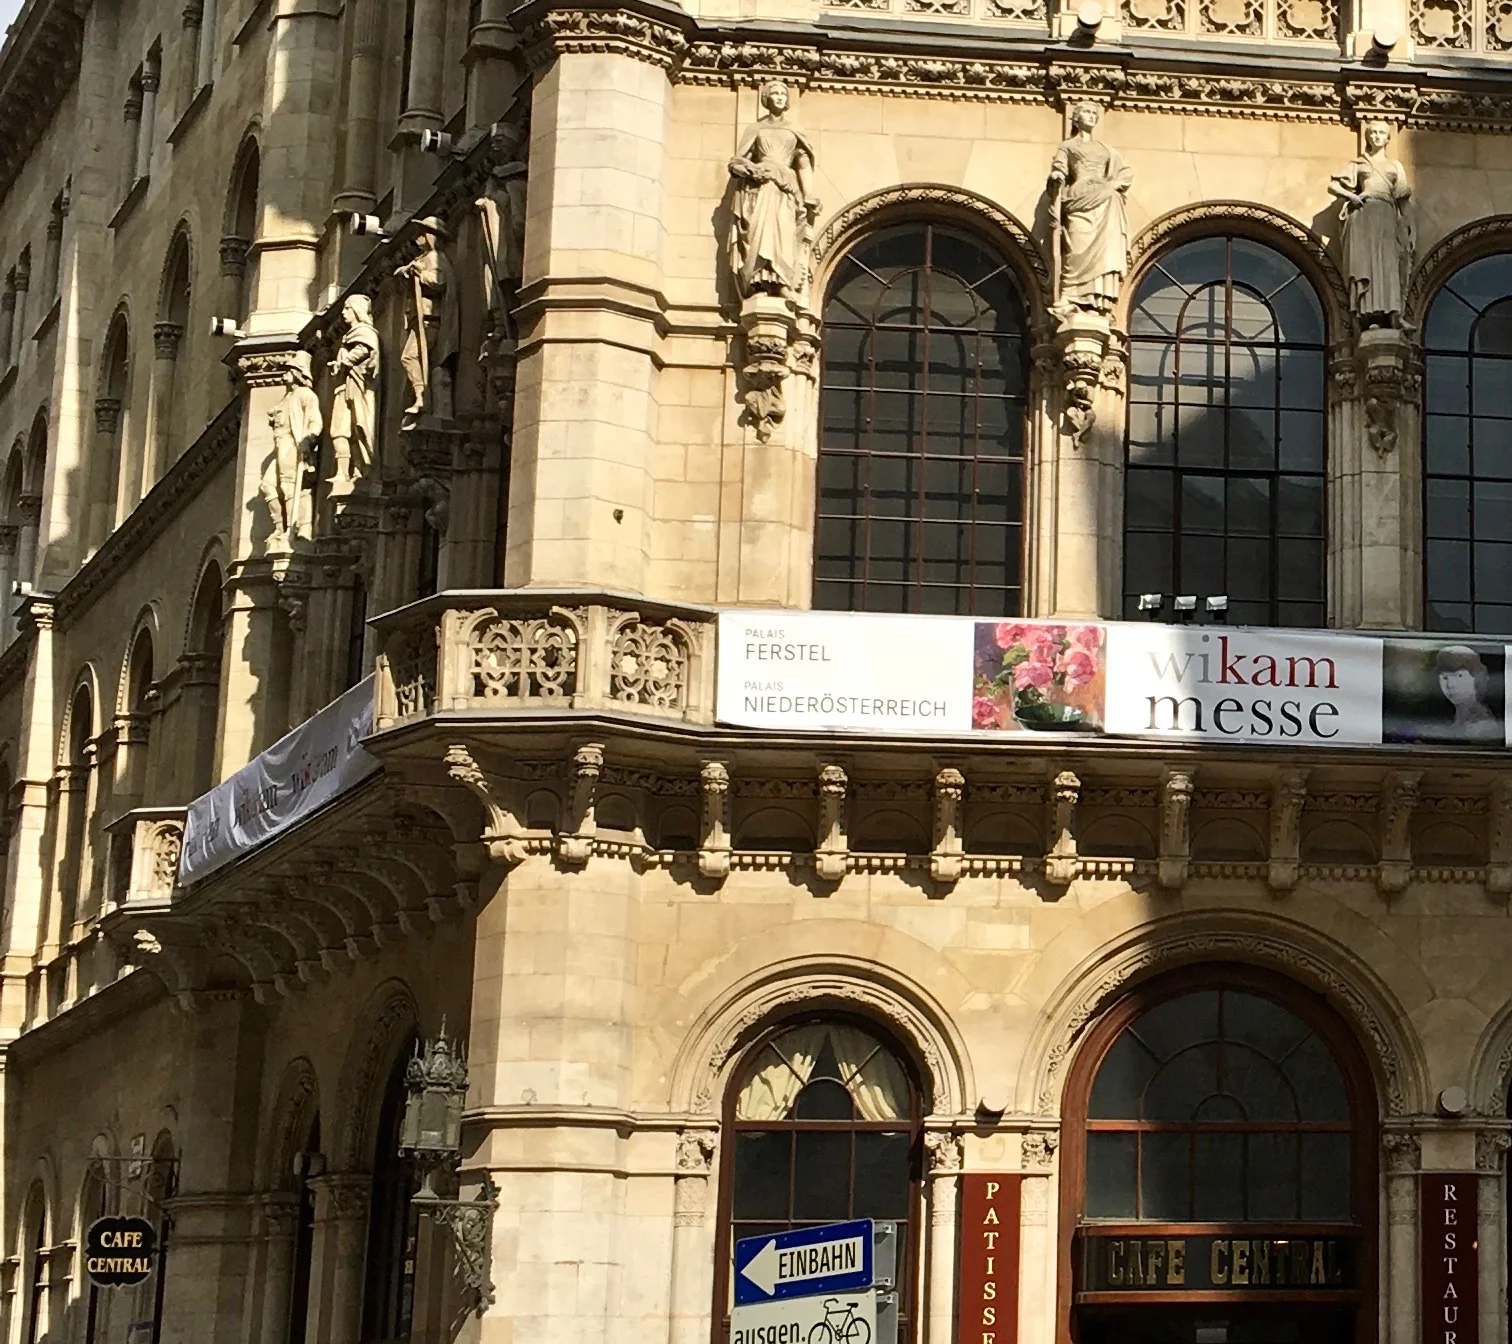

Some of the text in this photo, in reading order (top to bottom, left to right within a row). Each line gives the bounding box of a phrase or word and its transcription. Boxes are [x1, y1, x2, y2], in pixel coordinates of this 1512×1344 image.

[745, 628, 785, 640] PALAIS
[745, 643, 831, 662] FERSTEL
[1148, 635, 1339, 690] wikam
[744, 680, 784, 692] PALAIS
[744, 692, 947, 718] NIEDERÖSTERREICH
[1144, 692, 1340, 739] messe
[100, 1231, 143, 1248] CAFE
[87, 1258, 151, 1273] CENTRAL
[778, 1241, 857, 1279] EINBAHN
[1108, 1240, 1342, 1285] CAFE CENTRAL
